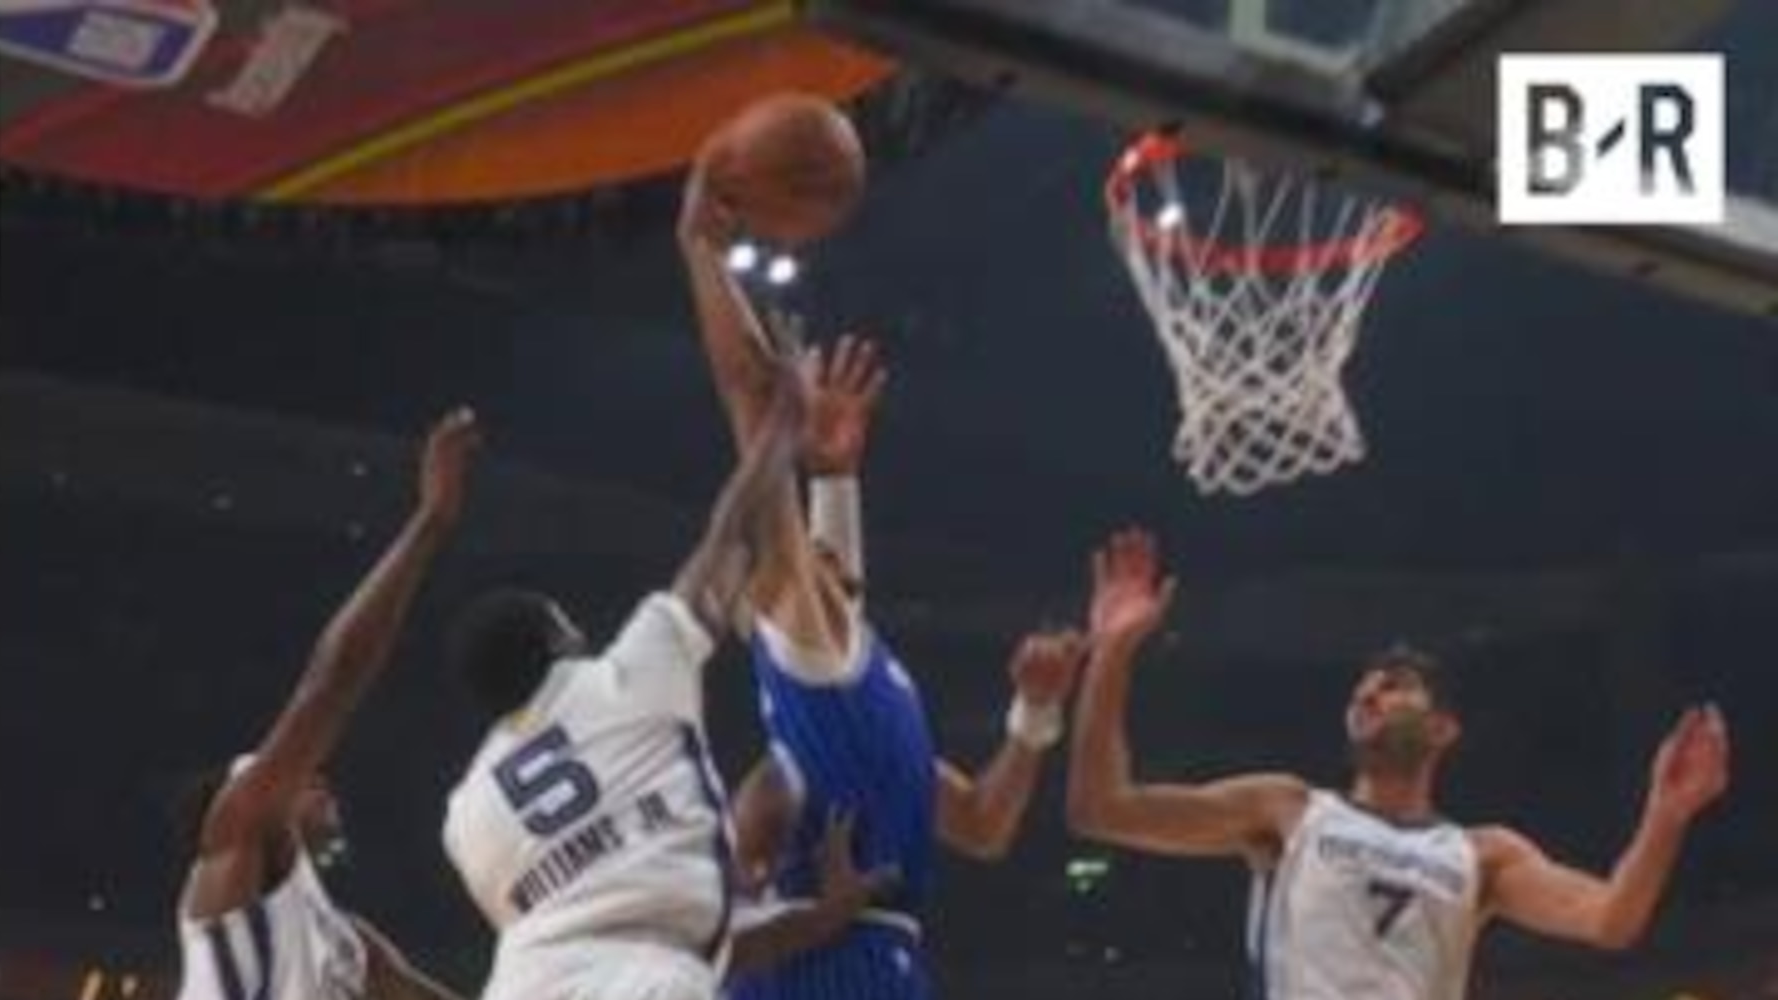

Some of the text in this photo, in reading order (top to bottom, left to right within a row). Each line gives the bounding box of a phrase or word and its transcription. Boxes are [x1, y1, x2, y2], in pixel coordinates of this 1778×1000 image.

[492, 723, 600, 837] 5
[510, 815, 625, 915] WILLIAMS
[1370, 879, 1415, 938] 7
